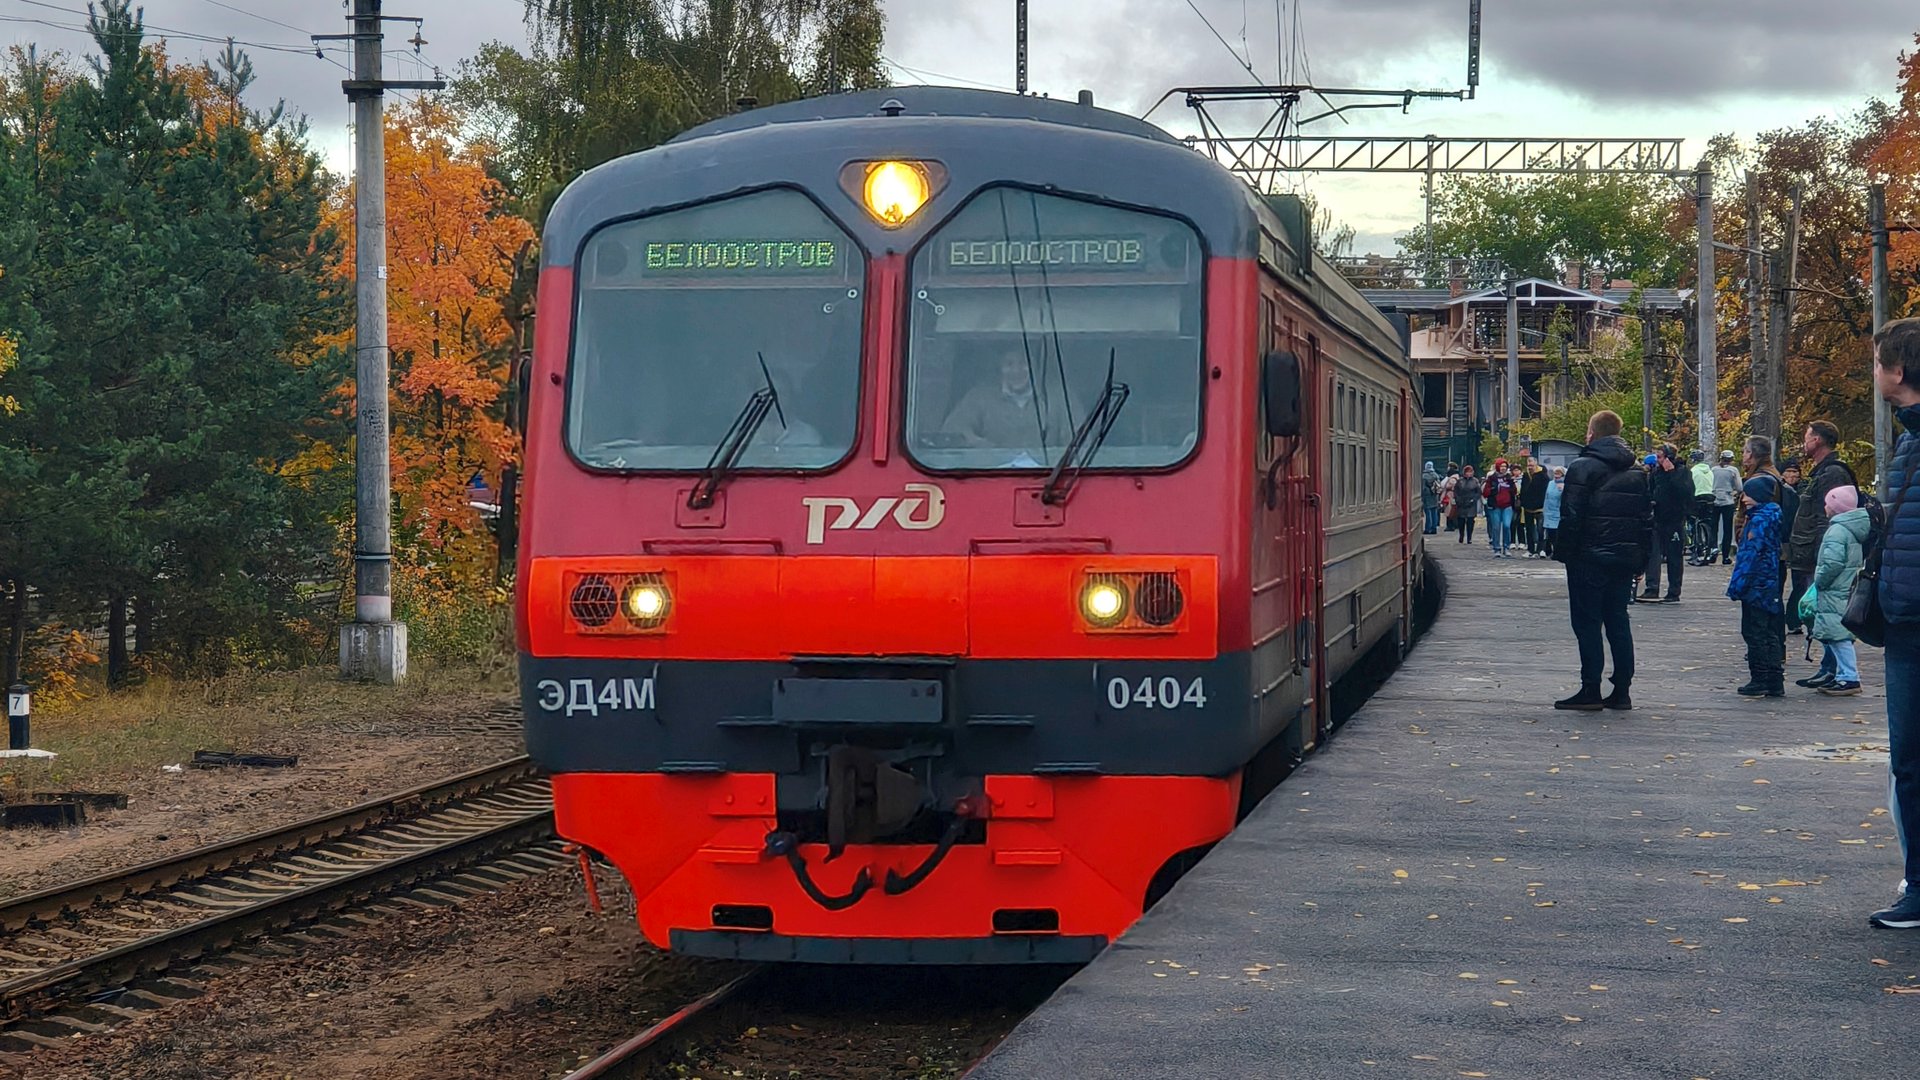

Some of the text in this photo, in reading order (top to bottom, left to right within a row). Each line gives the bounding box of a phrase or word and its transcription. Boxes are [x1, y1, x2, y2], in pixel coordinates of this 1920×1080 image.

[646, 241, 835, 268] БЕЛООСТРОВ
[950, 239, 1141, 265] БЕЛООСТРОВ
[12, 696, 22, 710] 7
[536, 678, 656, 717] ЭД4М
[1107, 676, 1208, 709] 0404
